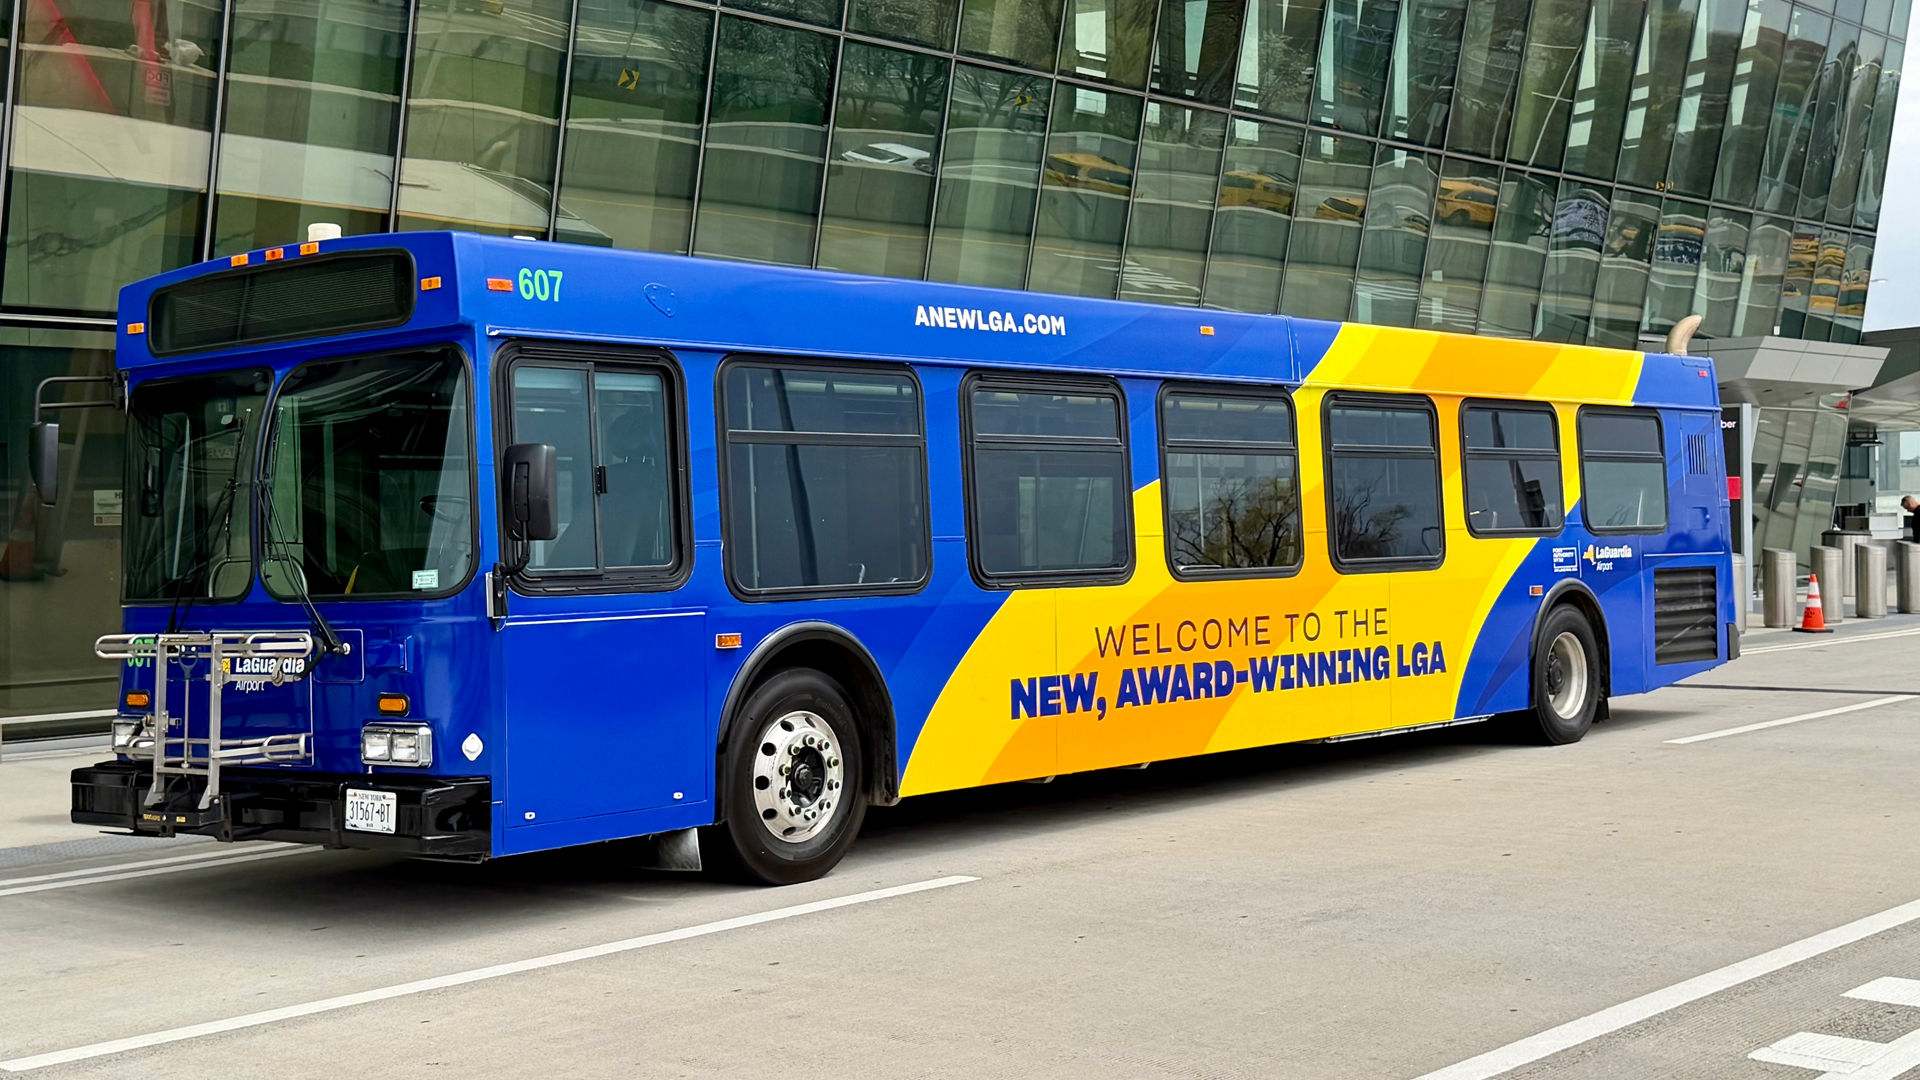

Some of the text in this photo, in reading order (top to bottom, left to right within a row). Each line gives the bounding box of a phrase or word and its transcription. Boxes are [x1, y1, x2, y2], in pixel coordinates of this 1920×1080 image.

[519, 267, 563, 302] 607
[915, 305, 1066, 336] ANEWLGA.COM
[1720, 420, 1736, 428] ber
[1596, 545, 1632, 559] LaGuardia
[1596, 561, 1613, 572] Airport
[1095, 608, 1388, 658] WELCOME TO THE
[235, 657, 305, 673] LaGuadia
[235, 681, 264, 694] Airport
[1010, 641, 1447, 721] NEW, AWARD-WINNING LGA
